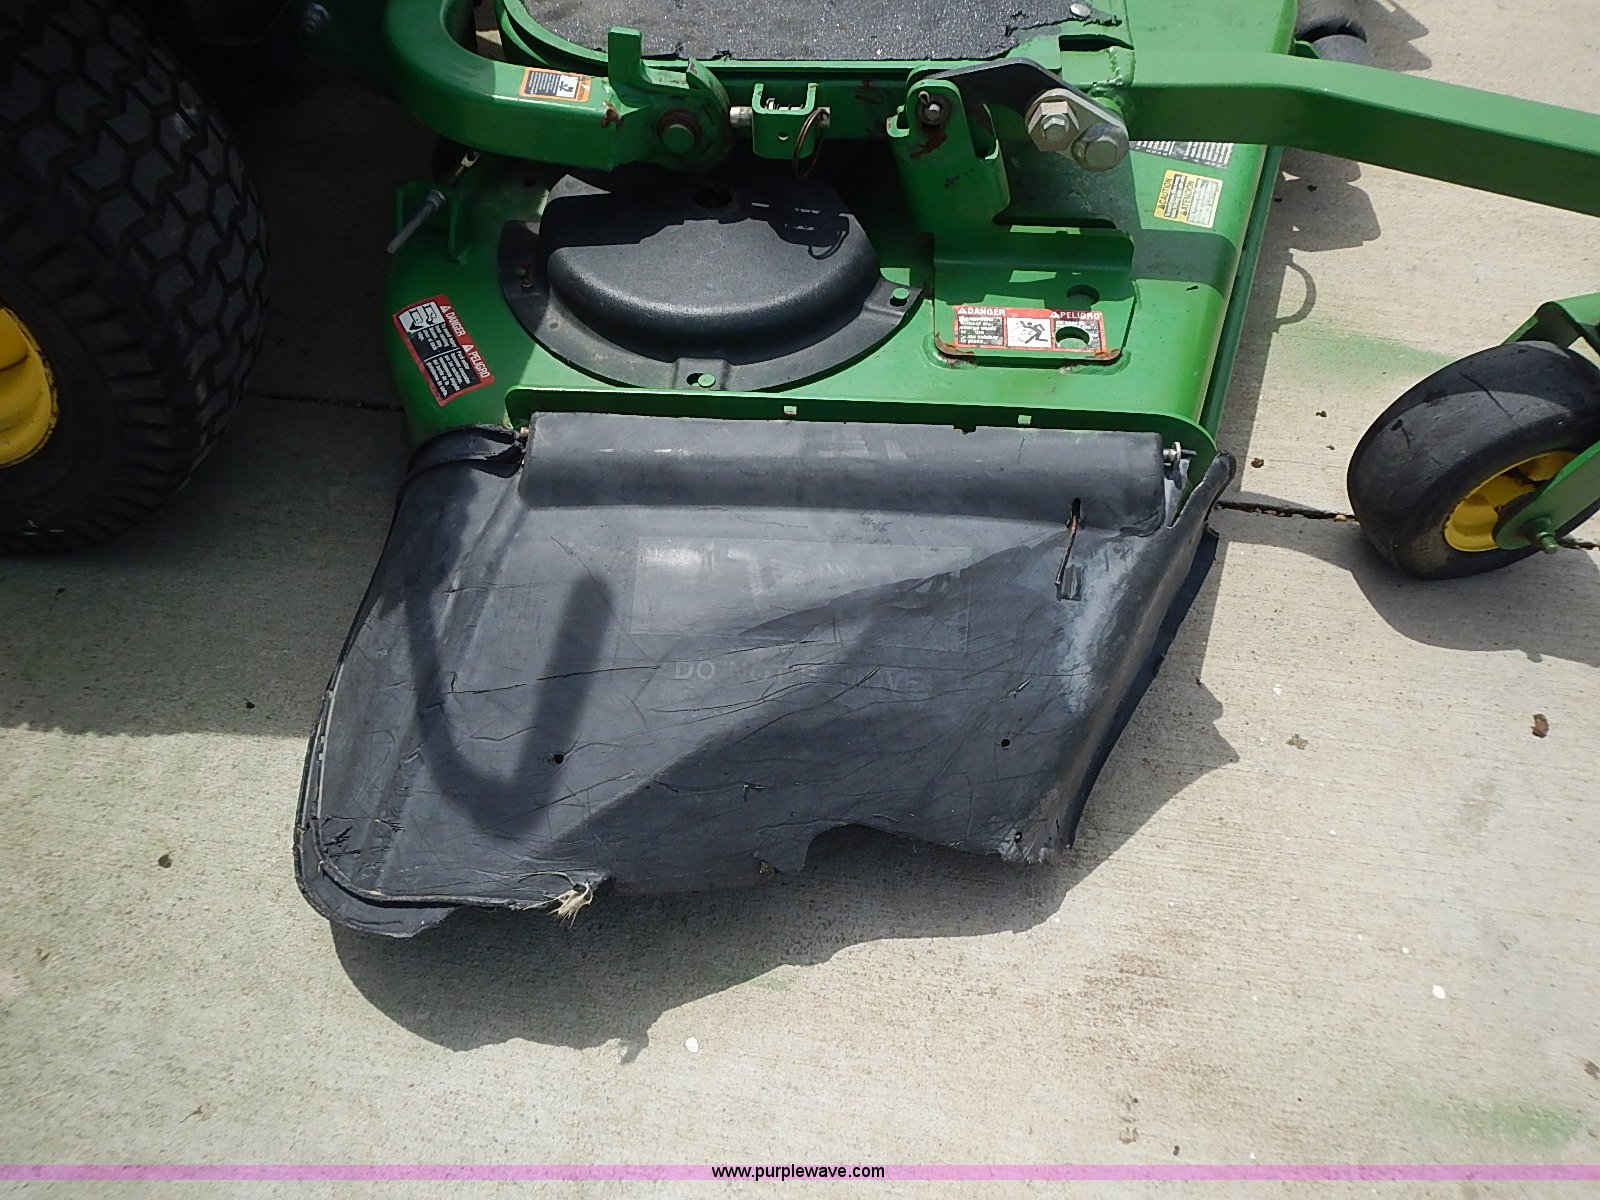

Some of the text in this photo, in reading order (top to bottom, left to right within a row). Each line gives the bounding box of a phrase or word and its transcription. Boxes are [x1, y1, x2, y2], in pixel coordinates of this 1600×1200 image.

[1158, 177, 1172, 205] CAUTION
[445, 311, 465, 335] DANGER
[1061, 312, 1100, 320] PELIGRO
[468, 351, 490, 379] PELIGRO
[674, 661, 716, 680] DO
